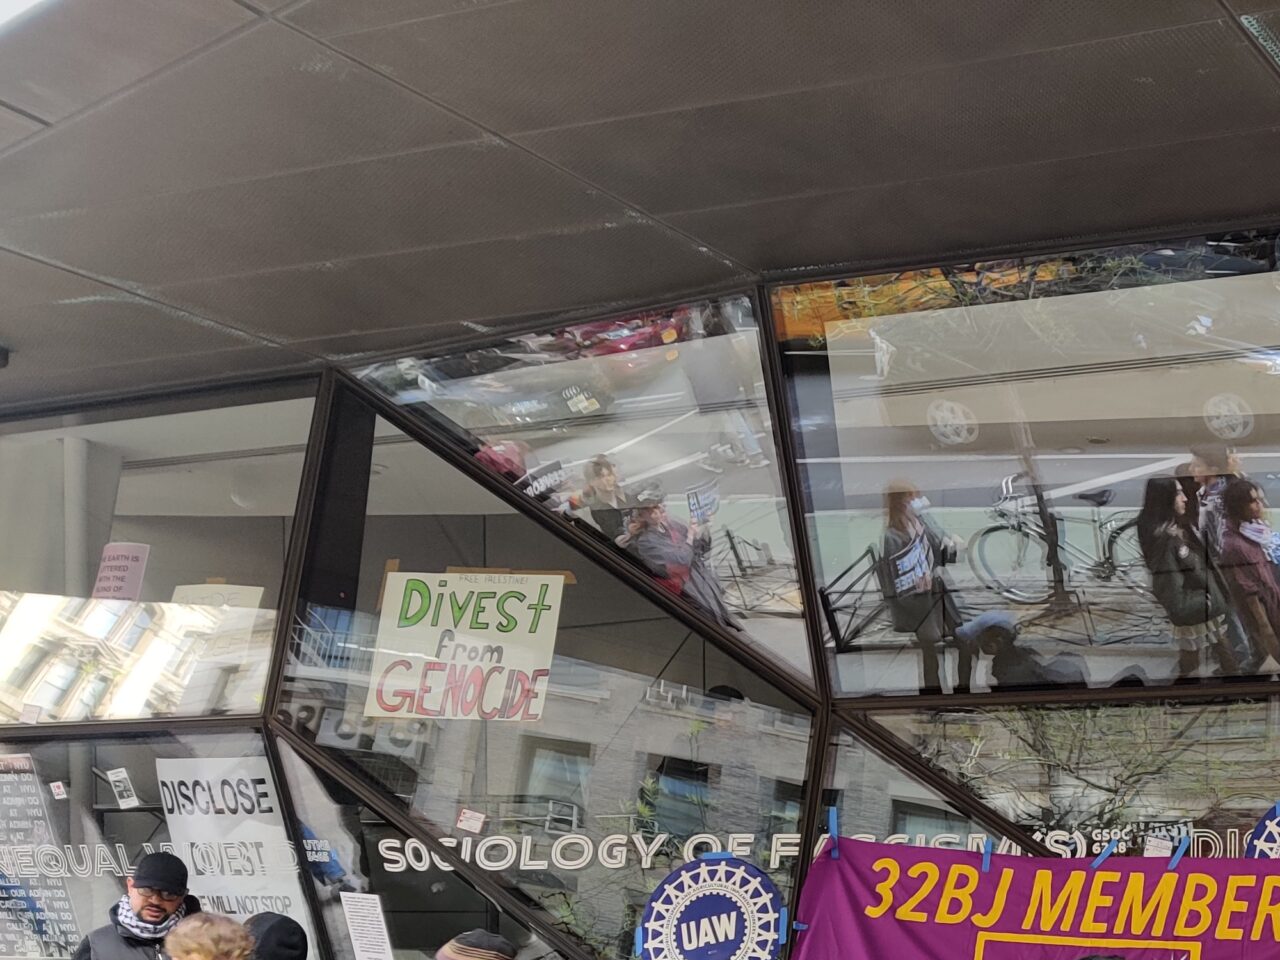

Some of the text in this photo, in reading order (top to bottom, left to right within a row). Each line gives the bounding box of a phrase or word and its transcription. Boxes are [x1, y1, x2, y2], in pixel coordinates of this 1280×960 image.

[374, 659, 550, 721] GENOCIDE
[160, 778, 273, 815] DISCLOSE
[863, 856, 1013, 927] 32BJ
[681, 911, 738, 951] UAW
